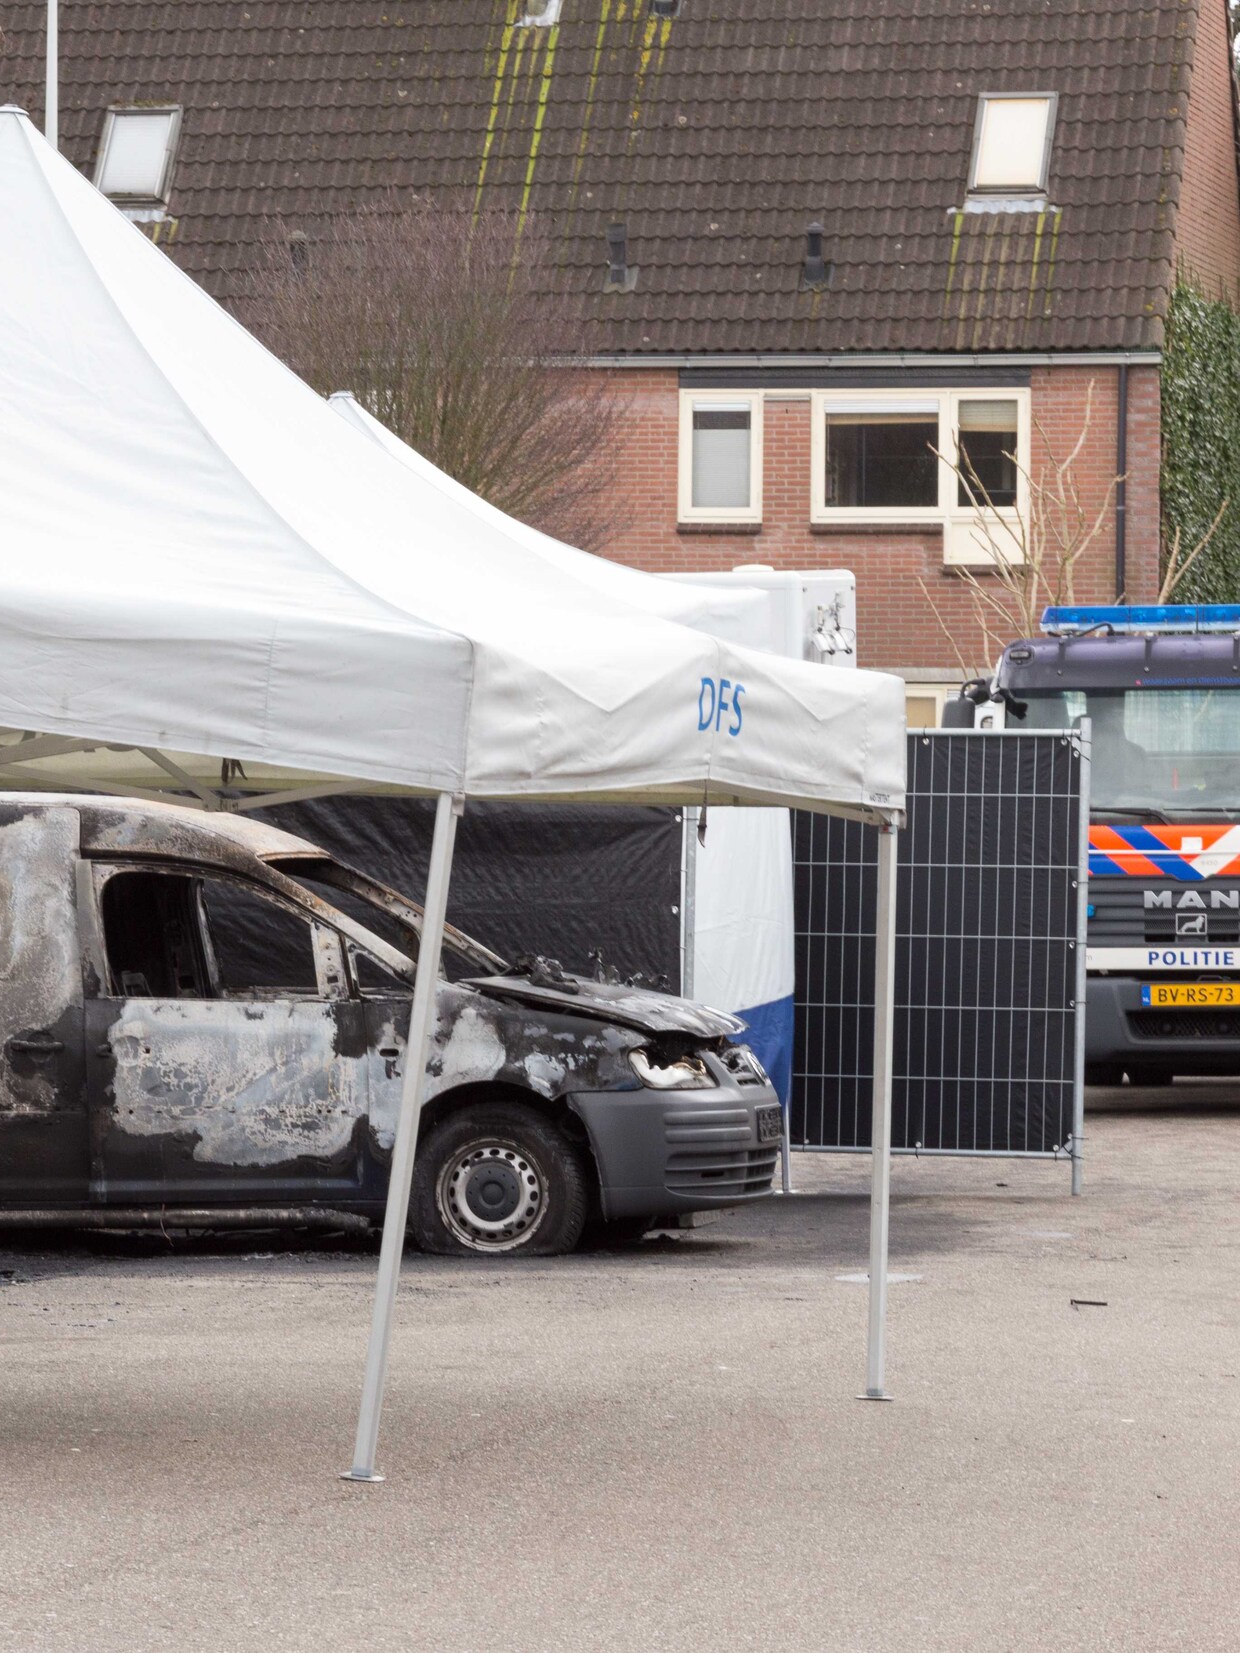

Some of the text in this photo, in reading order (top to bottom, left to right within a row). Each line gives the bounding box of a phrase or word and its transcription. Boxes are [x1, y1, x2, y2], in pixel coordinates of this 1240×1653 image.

[698, 677, 746, 737] DFS
[1144, 890, 1240, 909] MAN
[1148, 951, 1235, 966] POLITIE
[1158, 988, 1234, 1003] BV-RS-73
